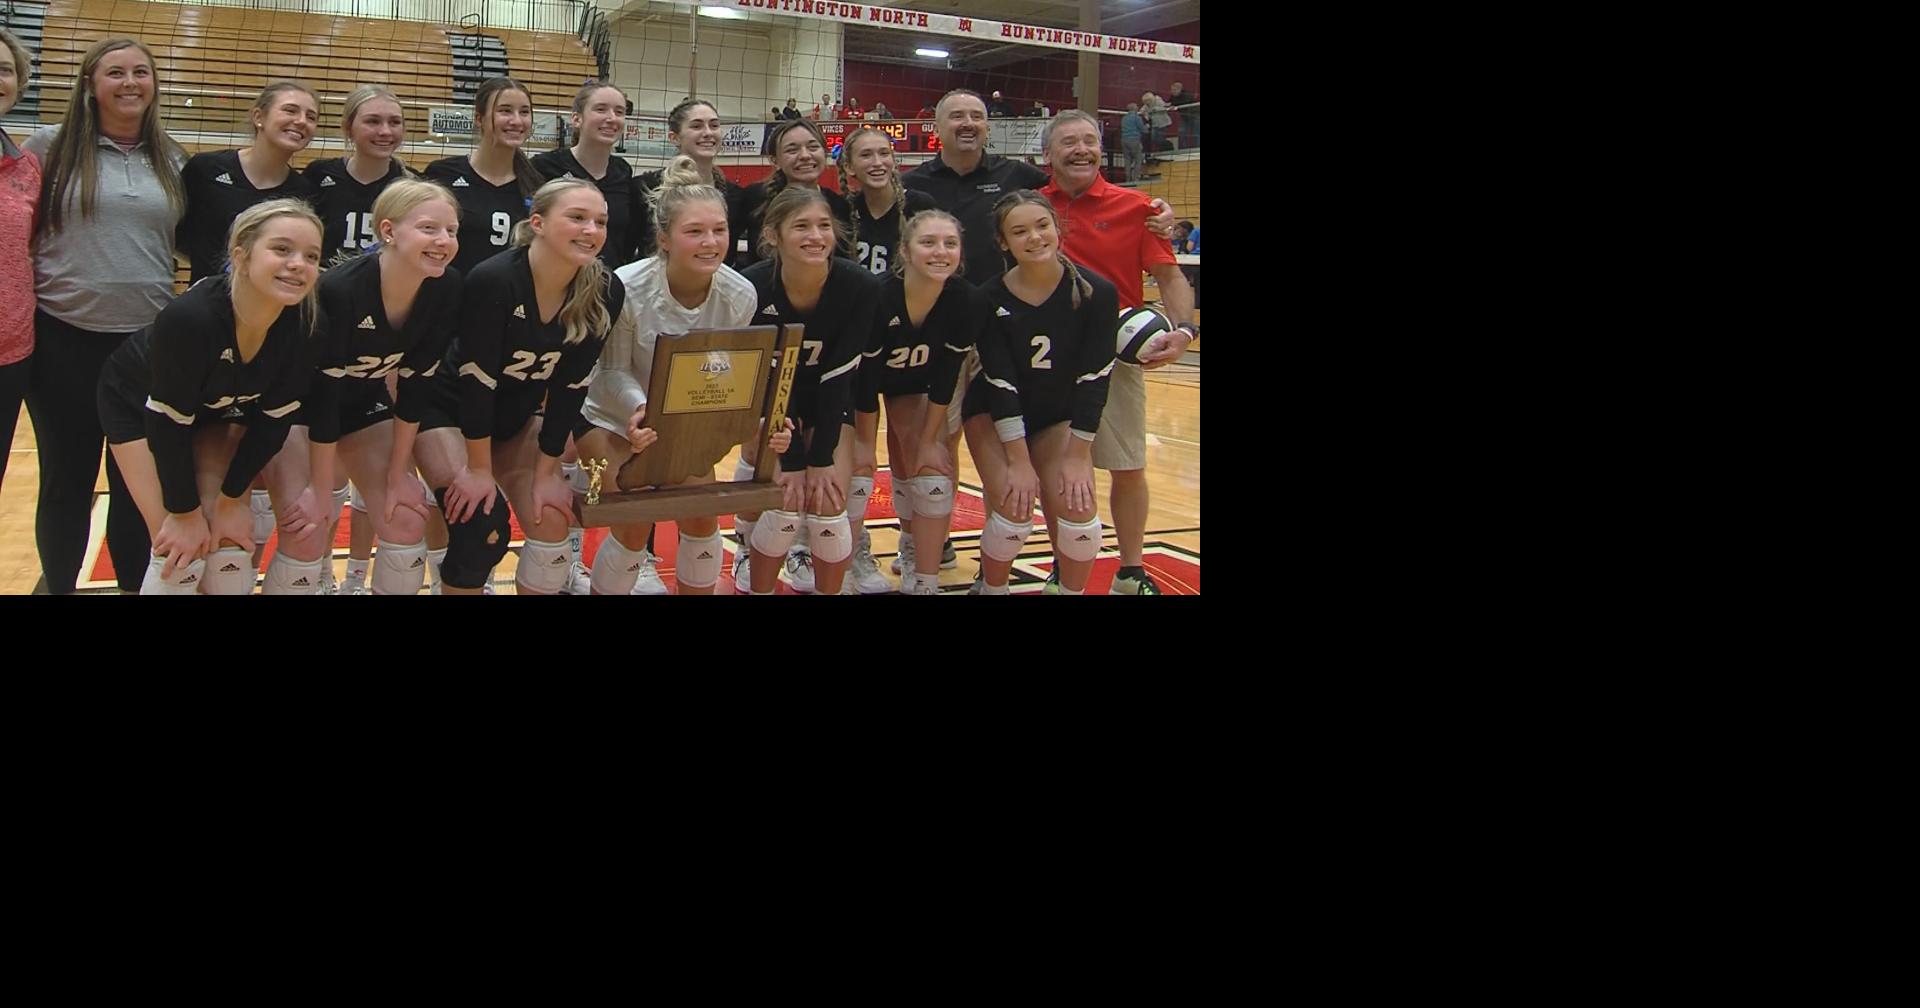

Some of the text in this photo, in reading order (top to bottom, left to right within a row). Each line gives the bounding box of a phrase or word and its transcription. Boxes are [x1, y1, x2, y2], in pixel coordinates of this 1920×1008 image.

[870, 7, 928, 27] NORTH
[1001, 24, 1101, 48] HUNTINGTON
[1108, 37, 1157, 54] NORTH
[822, 125, 844, 133] VIKES
[490, 211, 511, 246] 9
[857, 241, 888, 275] 26
[503, 349, 562, 381] 23
[887, 344, 929, 368] 20
[1030, 335, 1052, 369] 2
